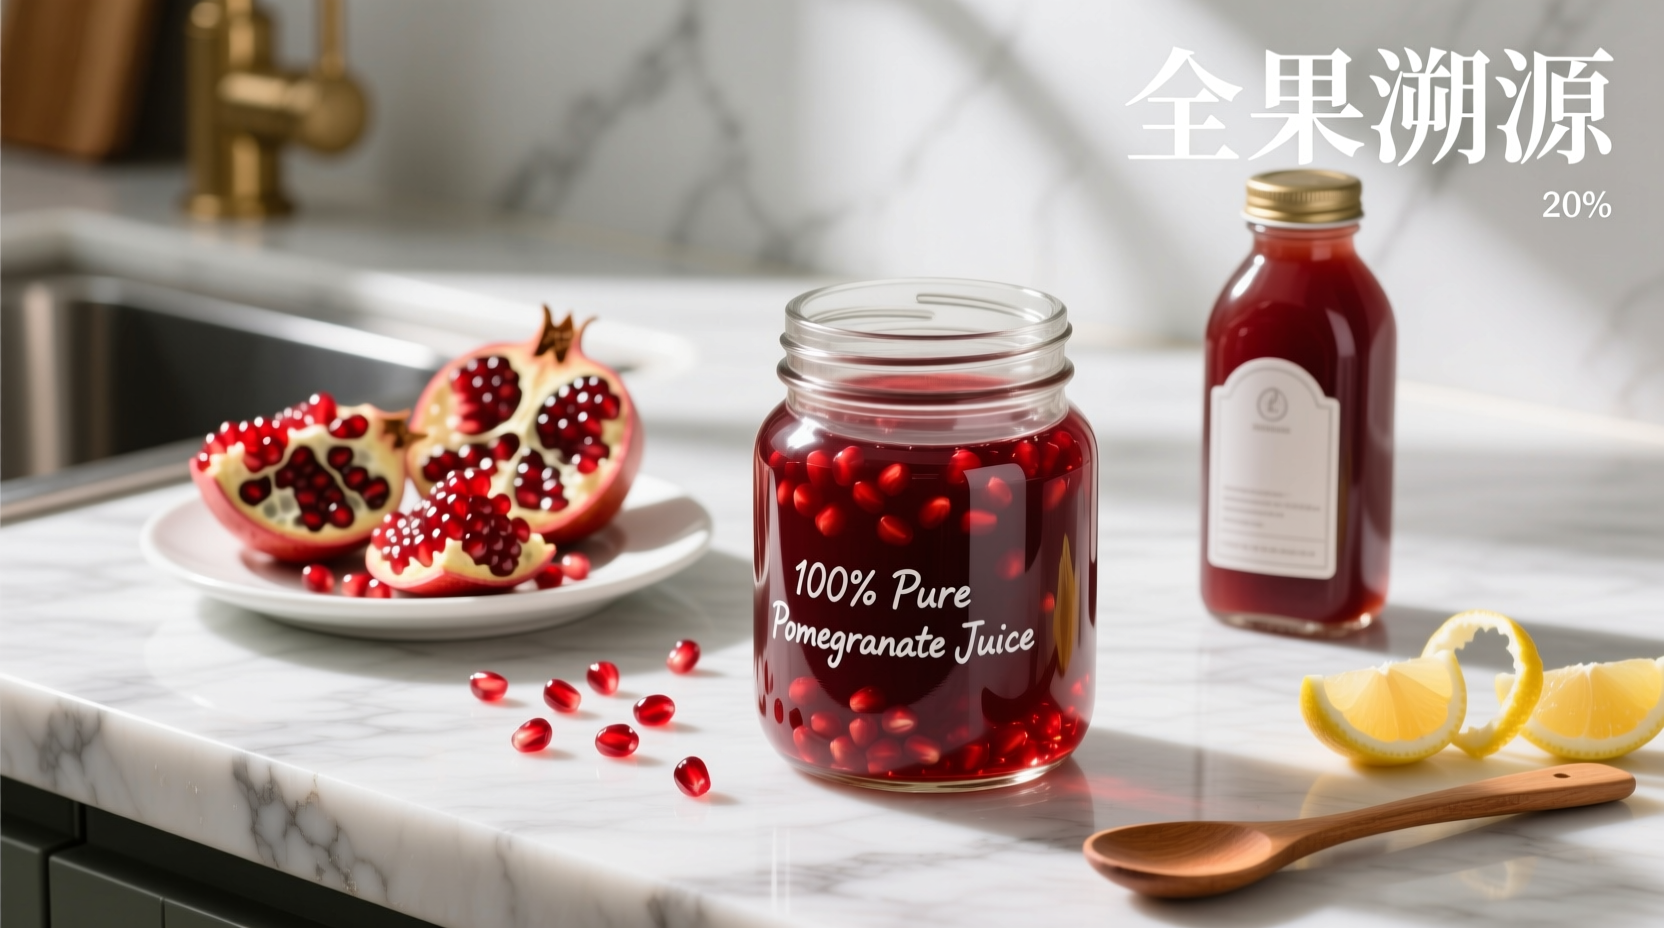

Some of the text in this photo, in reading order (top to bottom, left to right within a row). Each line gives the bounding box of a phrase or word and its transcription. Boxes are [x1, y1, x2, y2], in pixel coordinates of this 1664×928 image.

[795, 559, 972, 610] 100% Pure
[772, 600, 1035, 669] Pomegranate Juice
